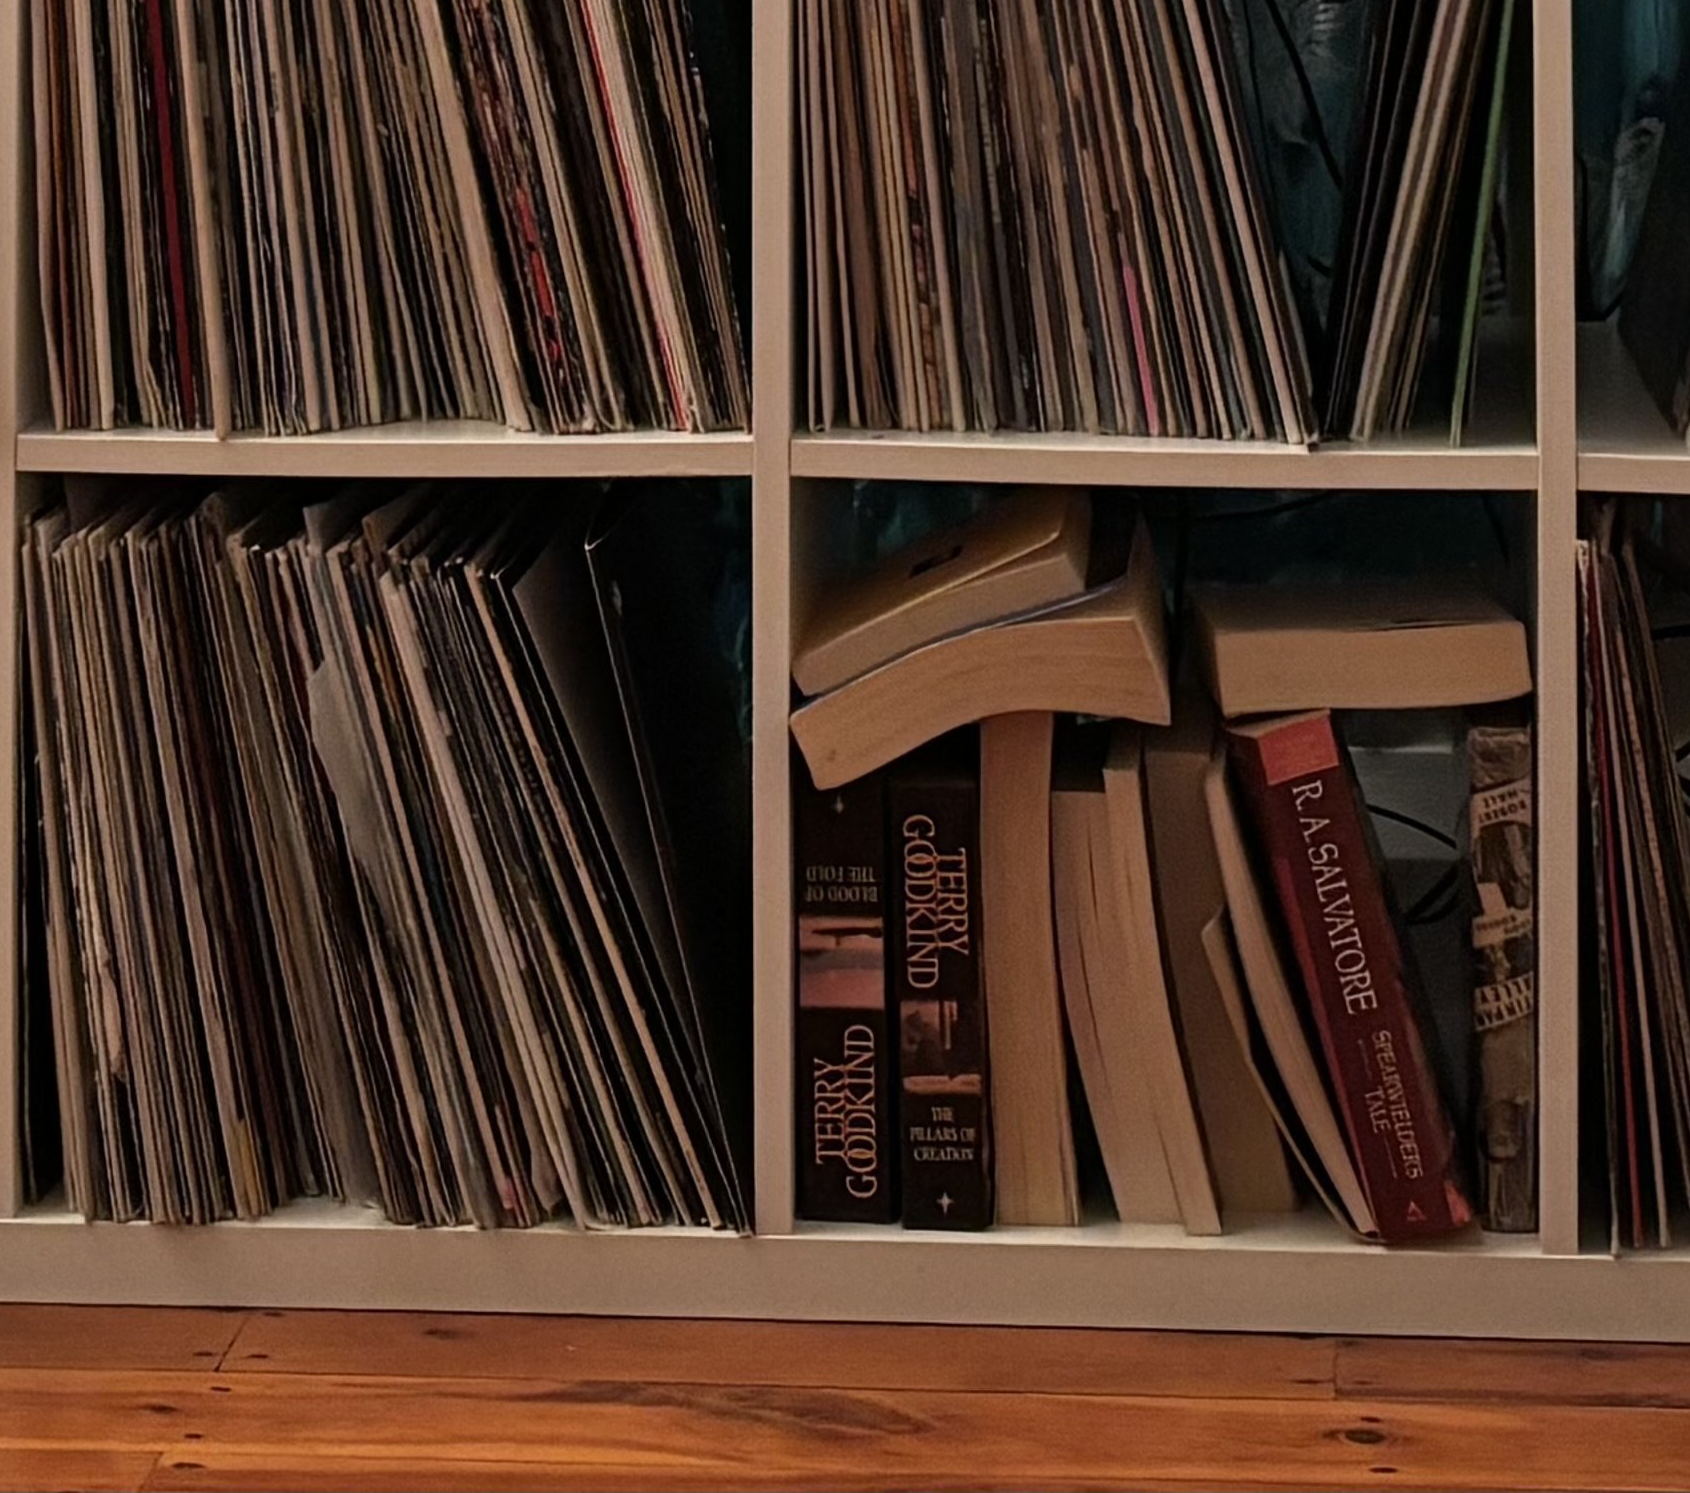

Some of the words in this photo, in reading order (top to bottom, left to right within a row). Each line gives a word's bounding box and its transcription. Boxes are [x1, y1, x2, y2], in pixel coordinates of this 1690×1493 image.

[902, 814, 939, 989] GOODKIND
[935, 847, 969, 955] TERRY
[1308, 842, 1379, 1016] SALVATORE
[813, 1057, 845, 1165] TERRY
[843, 1024, 878, 1199] GOODKIND
[909, 1126, 958, 1142] PILLARS
[930, 1106, 955, 1122] THE
[1364, 1085, 1392, 1134] TALE
